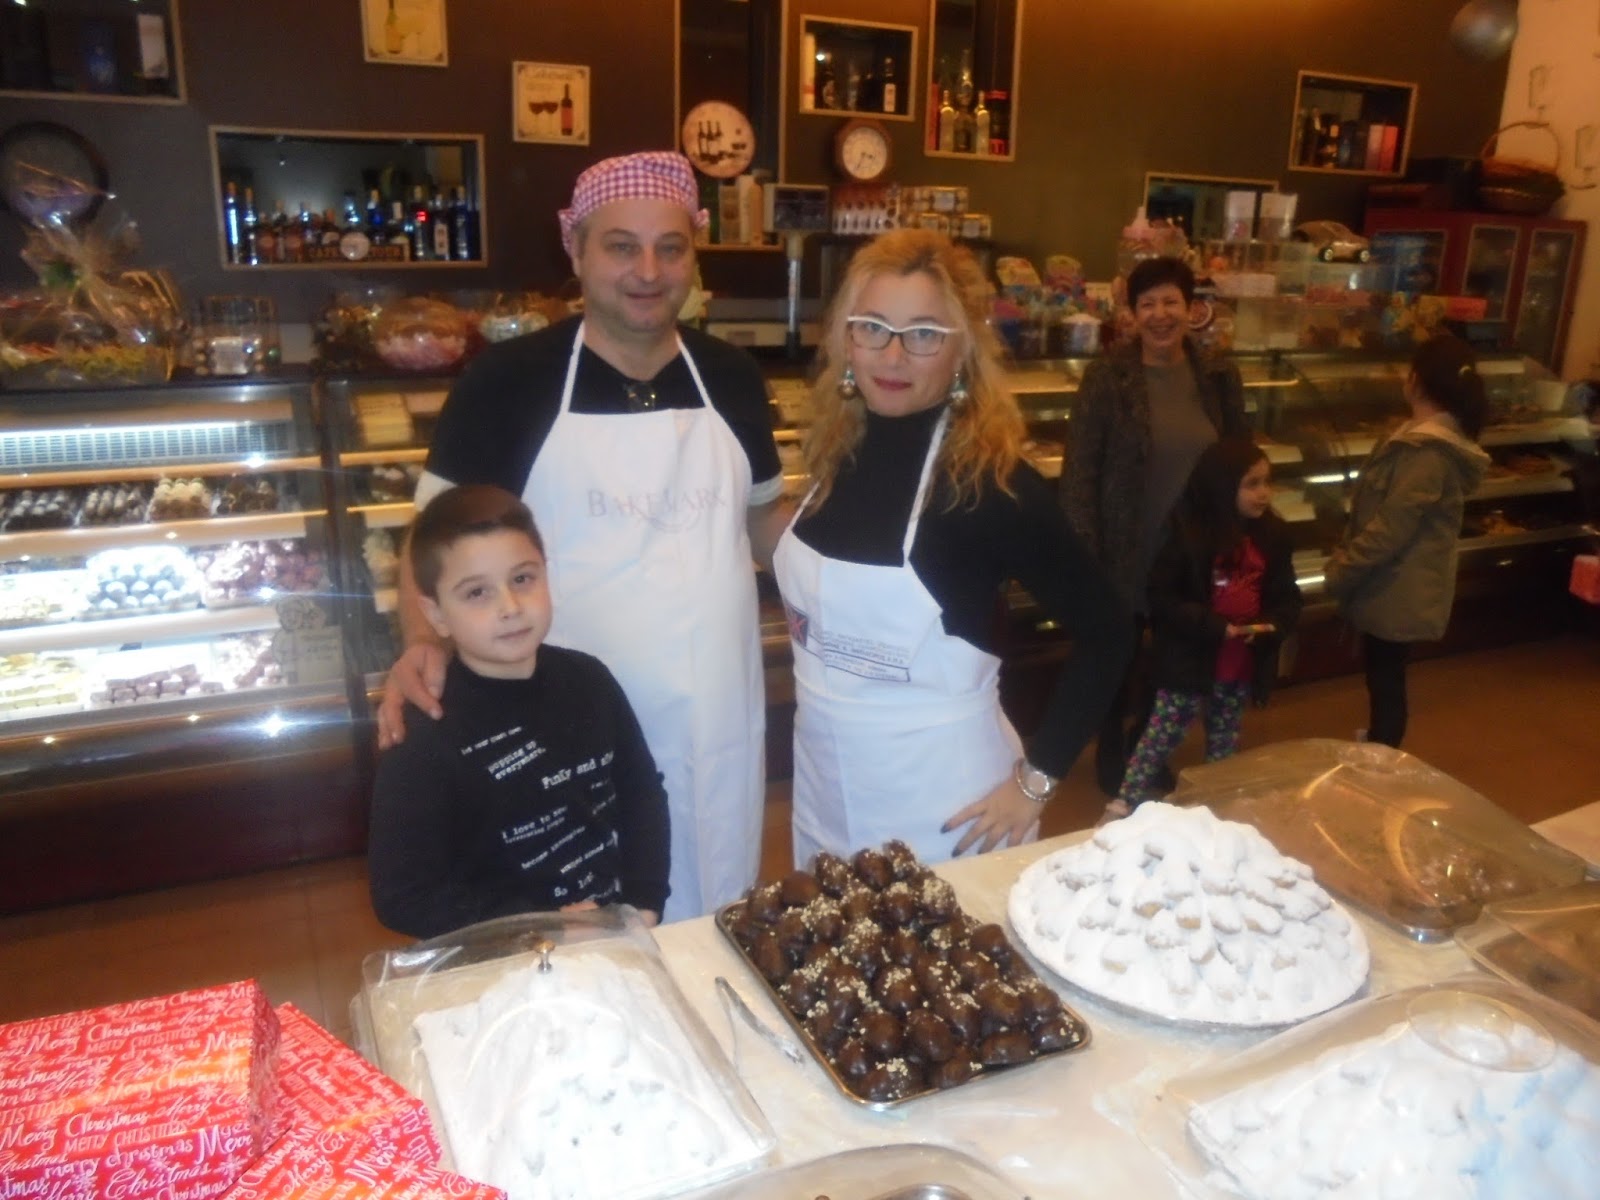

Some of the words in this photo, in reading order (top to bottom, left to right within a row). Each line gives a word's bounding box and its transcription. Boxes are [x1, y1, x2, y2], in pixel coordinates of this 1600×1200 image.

[576, 758, 597, 775] and
[513, 821, 535, 836] love
[540, 814, 551, 825] to
[554, 886, 568, 898] So
[24, 1032, 81, 1057] Merry
[87, 1021, 164, 1043] Christmas
[1, 1125, 59, 1151] Merry
[65, 1111, 150, 1138] Christmas
[105, 1162, 212, 1199] Christmas
